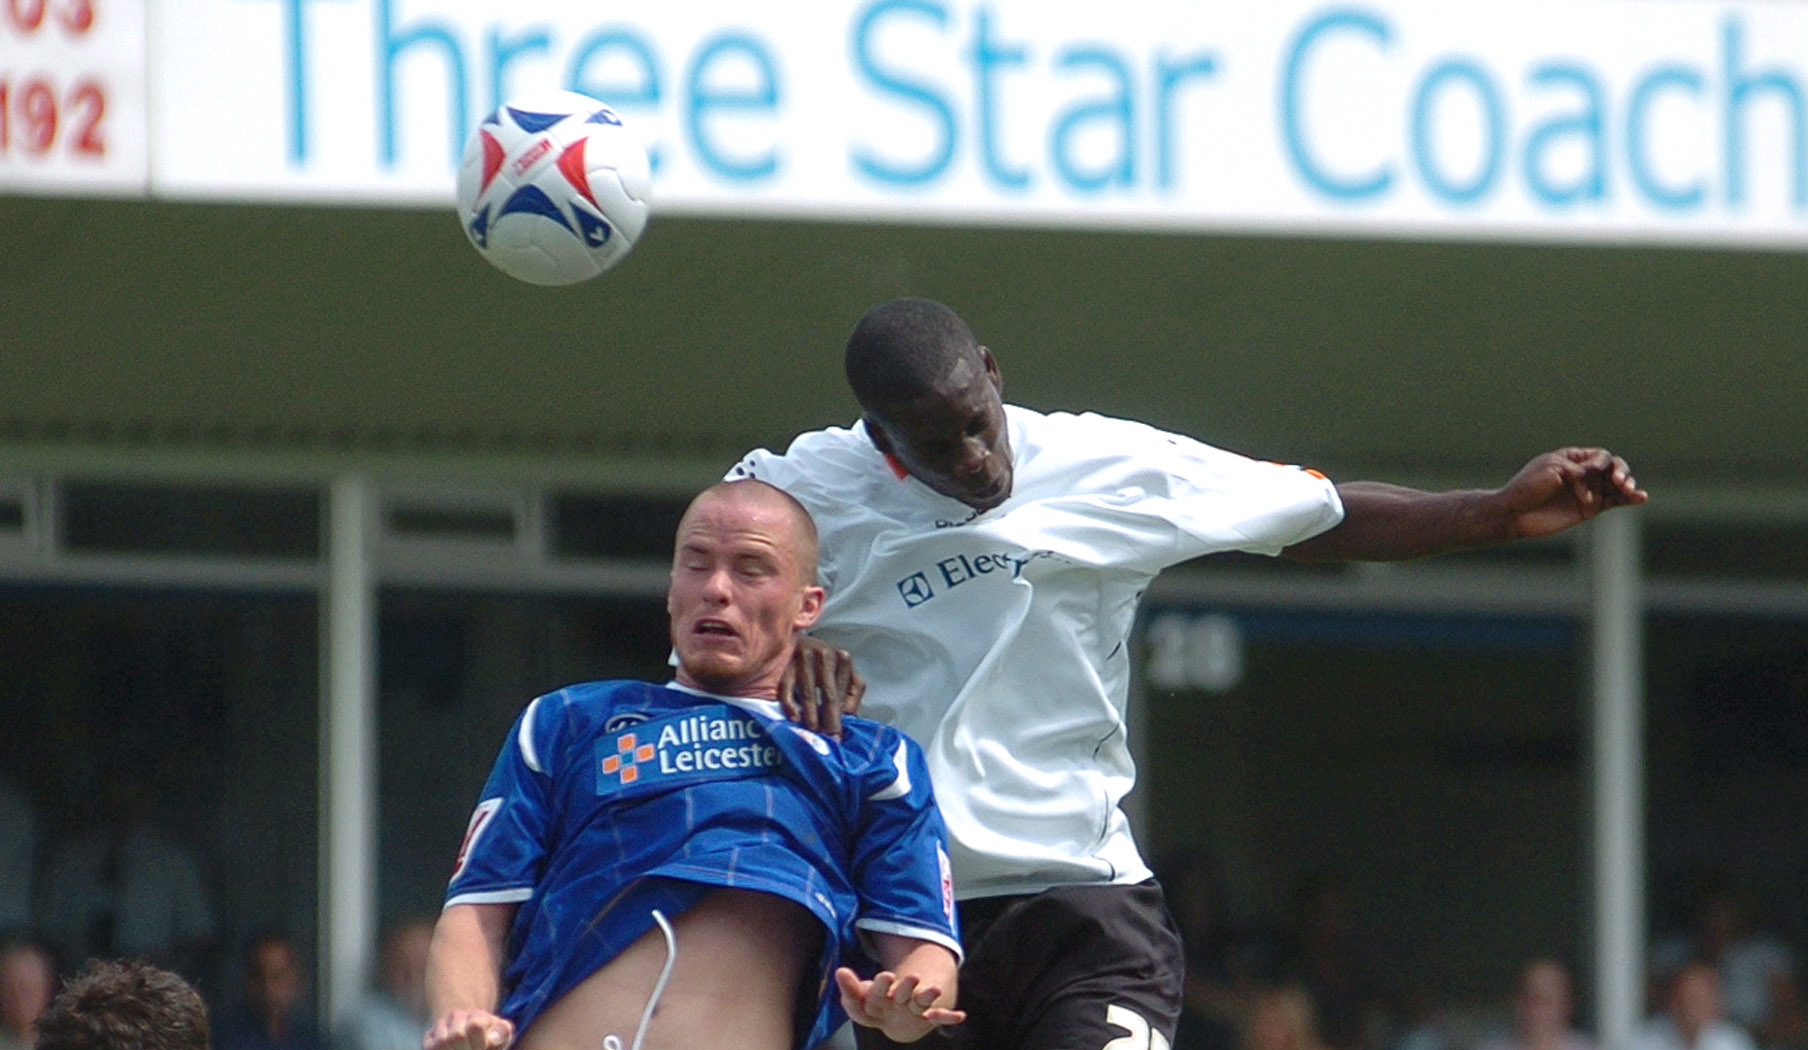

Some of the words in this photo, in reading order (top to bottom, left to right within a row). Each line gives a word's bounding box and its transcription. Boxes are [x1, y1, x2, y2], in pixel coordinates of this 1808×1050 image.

[236, 0, 783, 184] Three
[848, 0, 1218, 194] Star
[1277, 6, 1808, 212] Coach
